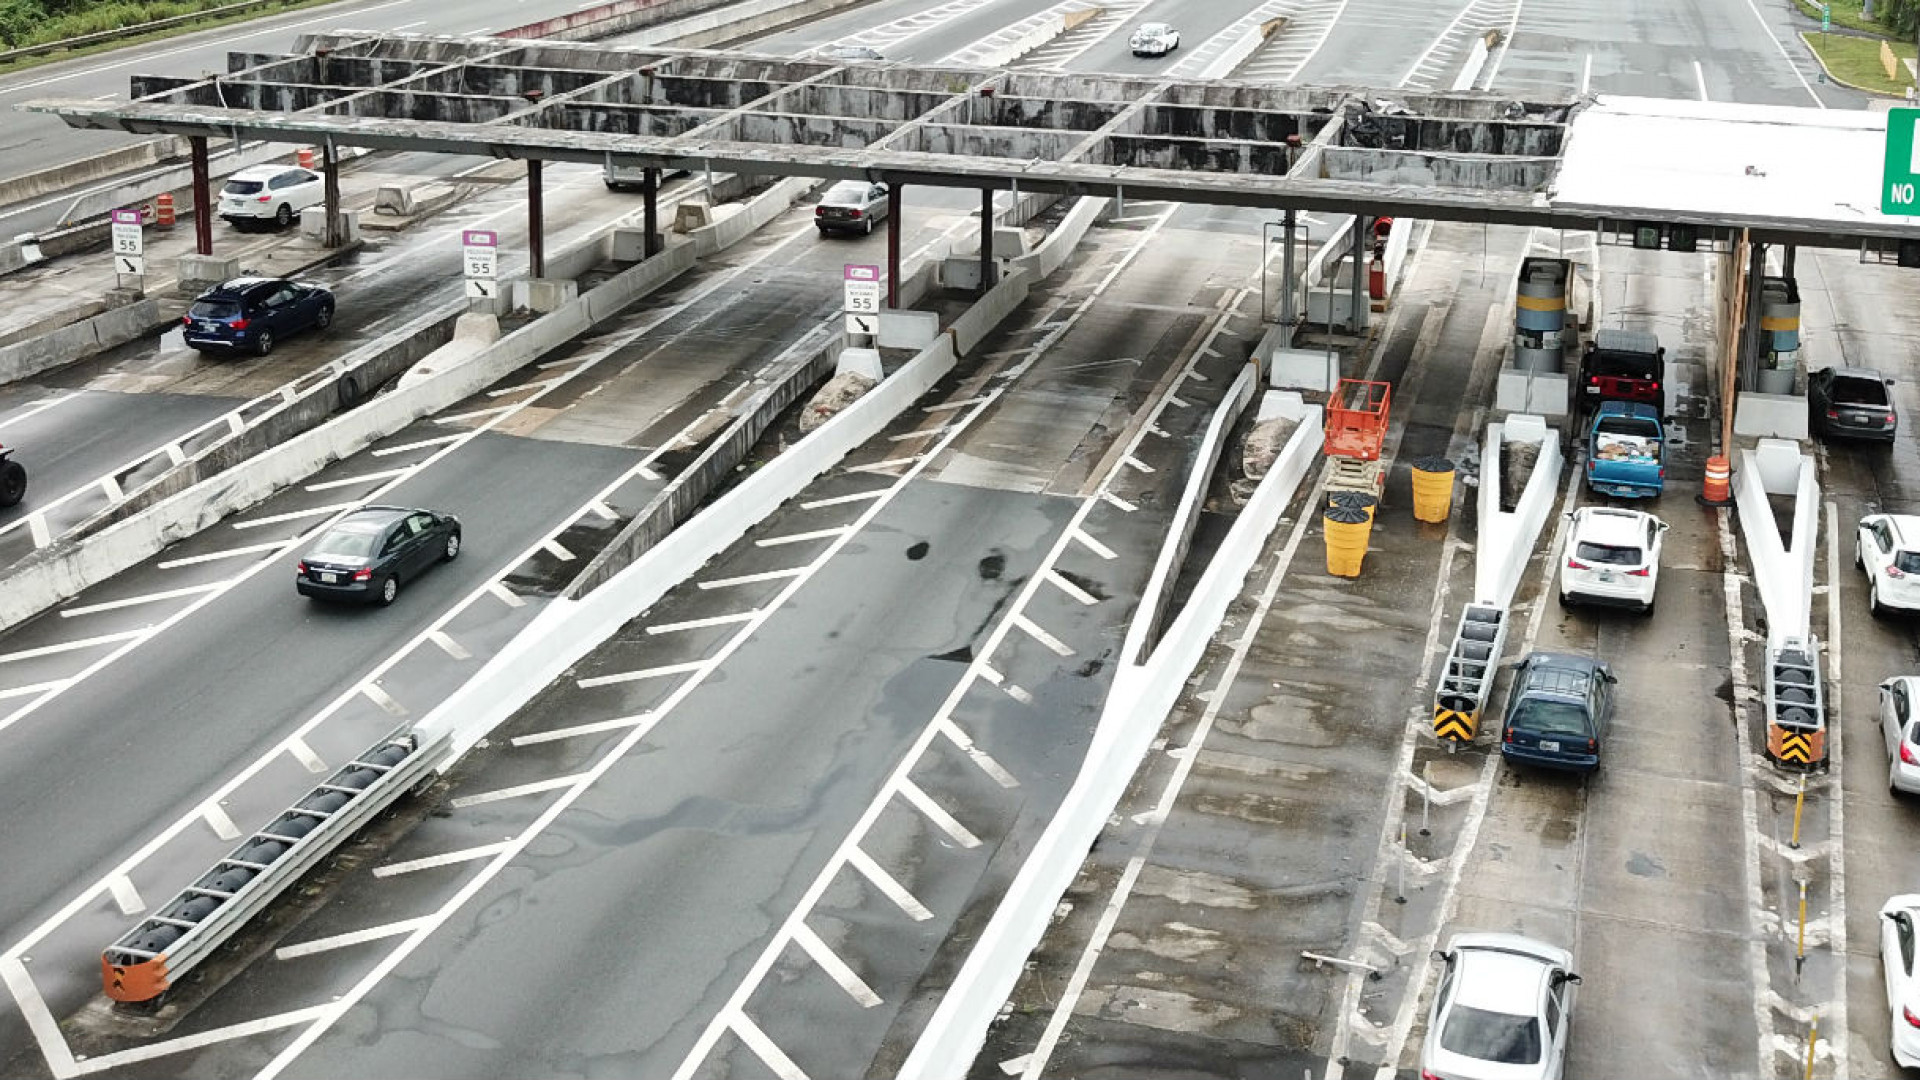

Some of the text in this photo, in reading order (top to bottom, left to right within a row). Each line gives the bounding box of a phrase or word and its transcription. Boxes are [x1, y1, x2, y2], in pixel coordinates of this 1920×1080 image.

[1891, 182, 1915, 204] NO
[120, 239, 136, 251] 55
[471, 263, 490, 274] 55
[853, 298, 872, 309] 55
